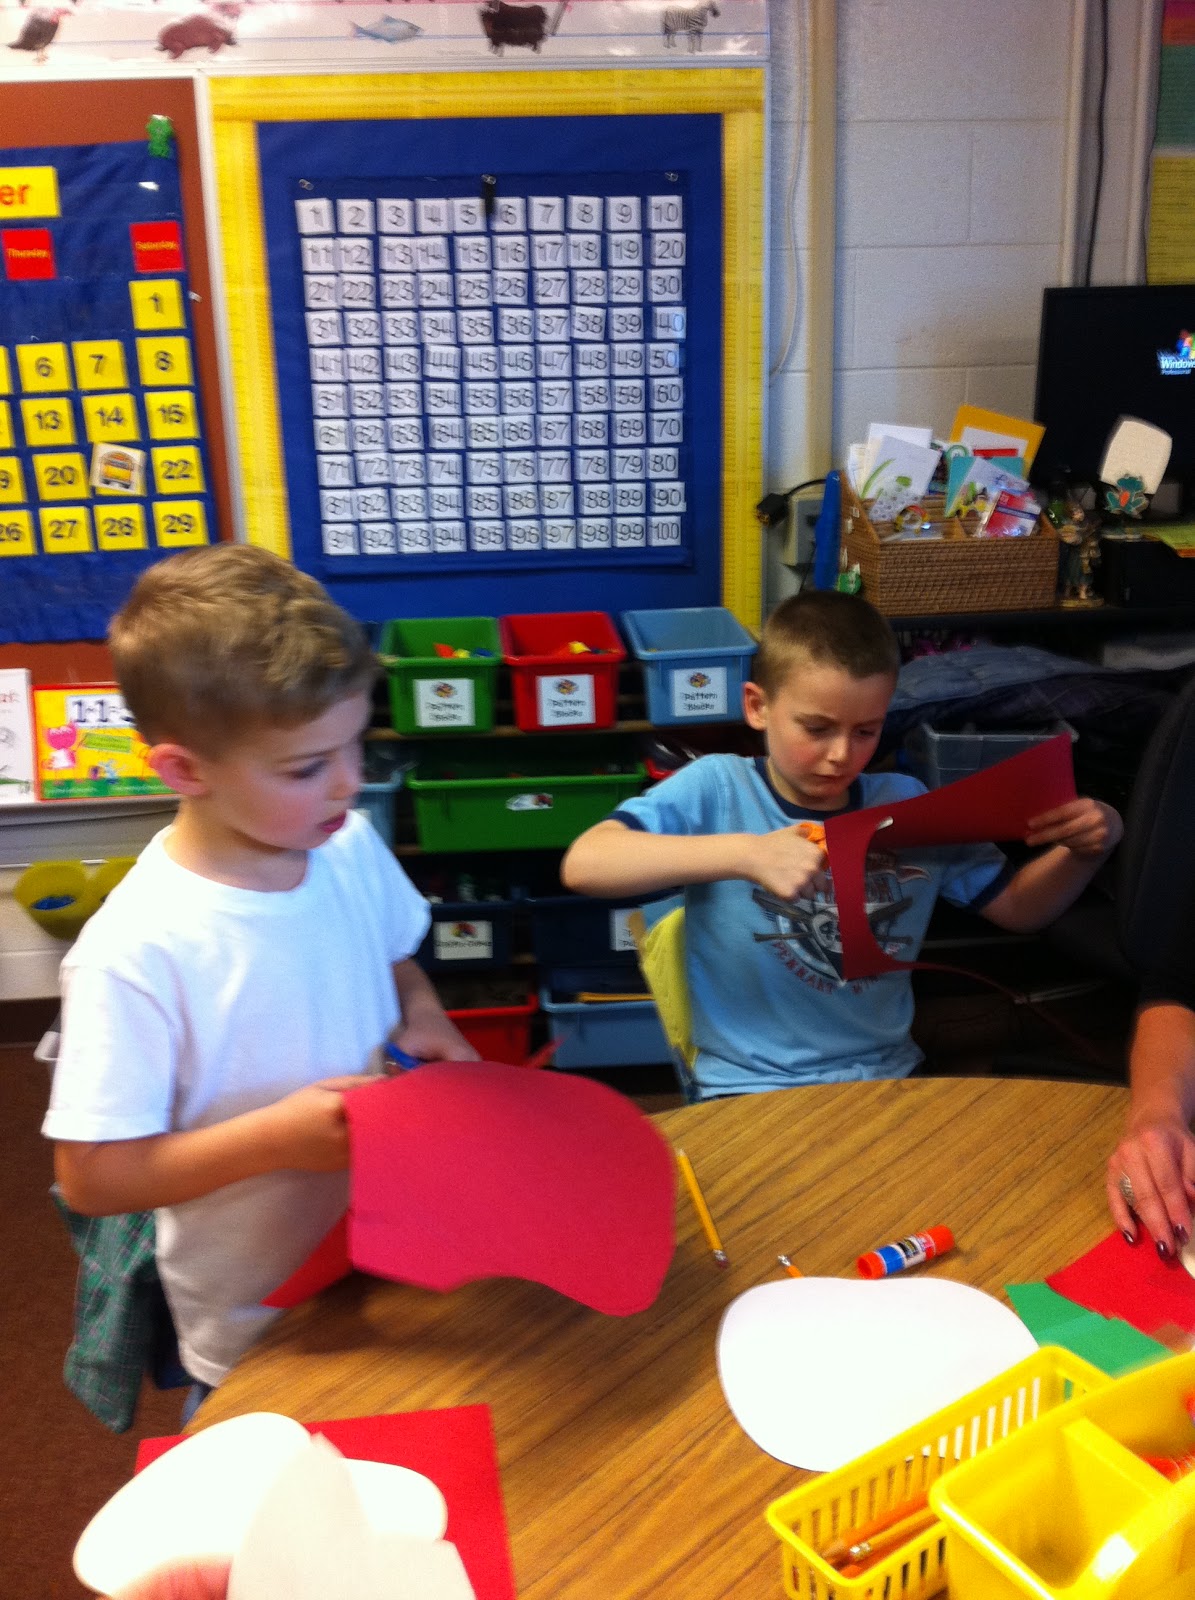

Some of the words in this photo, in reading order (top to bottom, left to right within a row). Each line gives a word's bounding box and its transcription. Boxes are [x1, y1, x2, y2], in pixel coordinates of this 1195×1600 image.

[310, 205, 323, 227] 1
[350, 206, 368, 228] 2
[388, 205, 406, 227] 3
[424, 204, 444, 226] 4
[461, 204, 477, 226] 5
[500, 204, 517, 225] 6
[538, 203, 556, 224] 7
[577, 203, 594, 224] 8
[616, 203, 632, 224] 9
[651, 202, 678, 223] 10
[8, 248, 49, 259] Thursday
[135, 240, 176, 252] Saturday
[308, 245, 332, 265] 11
[341, 245, 373, 267] 12
[383, 244, 414, 266] 13
[416, 243, 447, 265] 14
[460, 243, 489, 264] 15
[496, 242, 526, 264] 16
[535, 241, 563, 262] 17
[570, 241, 598, 262] 18
[613, 240, 640, 261] 19
[656, 240, 684, 260] 20
[310, 280, 335, 302] 21
[341, 280, 375, 302] 22
[383, 279, 415, 301] 23
[420, 279, 452, 301] 24
[459, 279, 491, 300] 25
[536, 277, 566, 299] 27
[576, 277, 605, 298] 28
[612, 276, 640, 297] 29
[651, 276, 680, 297] 30
[149, 292, 165, 314] 1
[349, 318, 379, 339] 32
[387, 317, 418, 339] 33
[423, 317, 455, 338] 34
[463, 317, 492, 338] 35
[501, 315, 531, 336] 36
[539, 315, 568, 335] 37
[574, 313, 603, 334] 38
[613, 314, 641, 335] 39
[655, 313, 684, 333] 40
[35, 356, 53, 379] 6
[89, 354, 106, 376] 7
[156, 350, 174, 373] 8
[348, 354, 380, 376] 42
[387, 353, 420, 375] 43
[466, 352, 498, 374] 45
[503, 352, 533, 372] 46
[541, 352, 570, 372] 47
[577, 351, 607, 371] 48
[613, 350, 642, 370] 49
[650, 350, 678, 370] 50
[354, 389, 384, 411] 52
[388, 388, 418, 410] 53
[428, 388, 460, 409] 54
[464, 388, 497, 409] 55
[540, 386, 570, 407] 57
[580, 385, 609, 406] 58
[616, 385, 642, 405] 59
[655, 384, 681, 404] 60
[34, 409, 63, 430] 13
[96, 406, 126, 428] 14
[157, 404, 187, 425] 15
[355, 424, 385, 446] 62
[391, 424, 421, 445] 63
[432, 423, 463, 443] 64
[469, 422, 500, 443] 65
[502, 420, 532, 442] 66
[540, 420, 569, 441] 67
[576, 419, 605, 440] 68
[615, 419, 644, 439] 69
[652, 418, 681, 438] 70
[44, 466, 78, 487] 20
[159, 459, 191, 480] 22
[322, 461, 348, 481] 71
[357, 457, 390, 478] 72
[393, 459, 424, 479] 73
[429, 459, 460, 478] 74
[469, 458, 500, 478] 75
[540, 457, 569, 476] 77
[578, 455, 607, 476] 78
[615, 455, 643, 474] 79
[650, 453, 677, 473] 80
[357, 494, 388, 515] 82
[431, 493, 461, 513] 84
[471, 492, 500, 512] 85
[509, 491, 537, 511] 86
[543, 490, 571, 510] 87
[580, 489, 611, 509] 88
[615, 489, 643, 508] 89
[654, 488, 682, 508] 90
[49, 519, 77, 540] 27
[102, 516, 135, 538] 28
[161, 513, 194, 534] 29
[432, 527, 466, 547] 94
[475, 526, 504, 546] 95
[510, 526, 540, 546] 96
[545, 525, 574, 545] 97
[580, 524, 610, 543] 98
[614, 523, 645, 542] 99
[649, 522, 680, 541] 100
